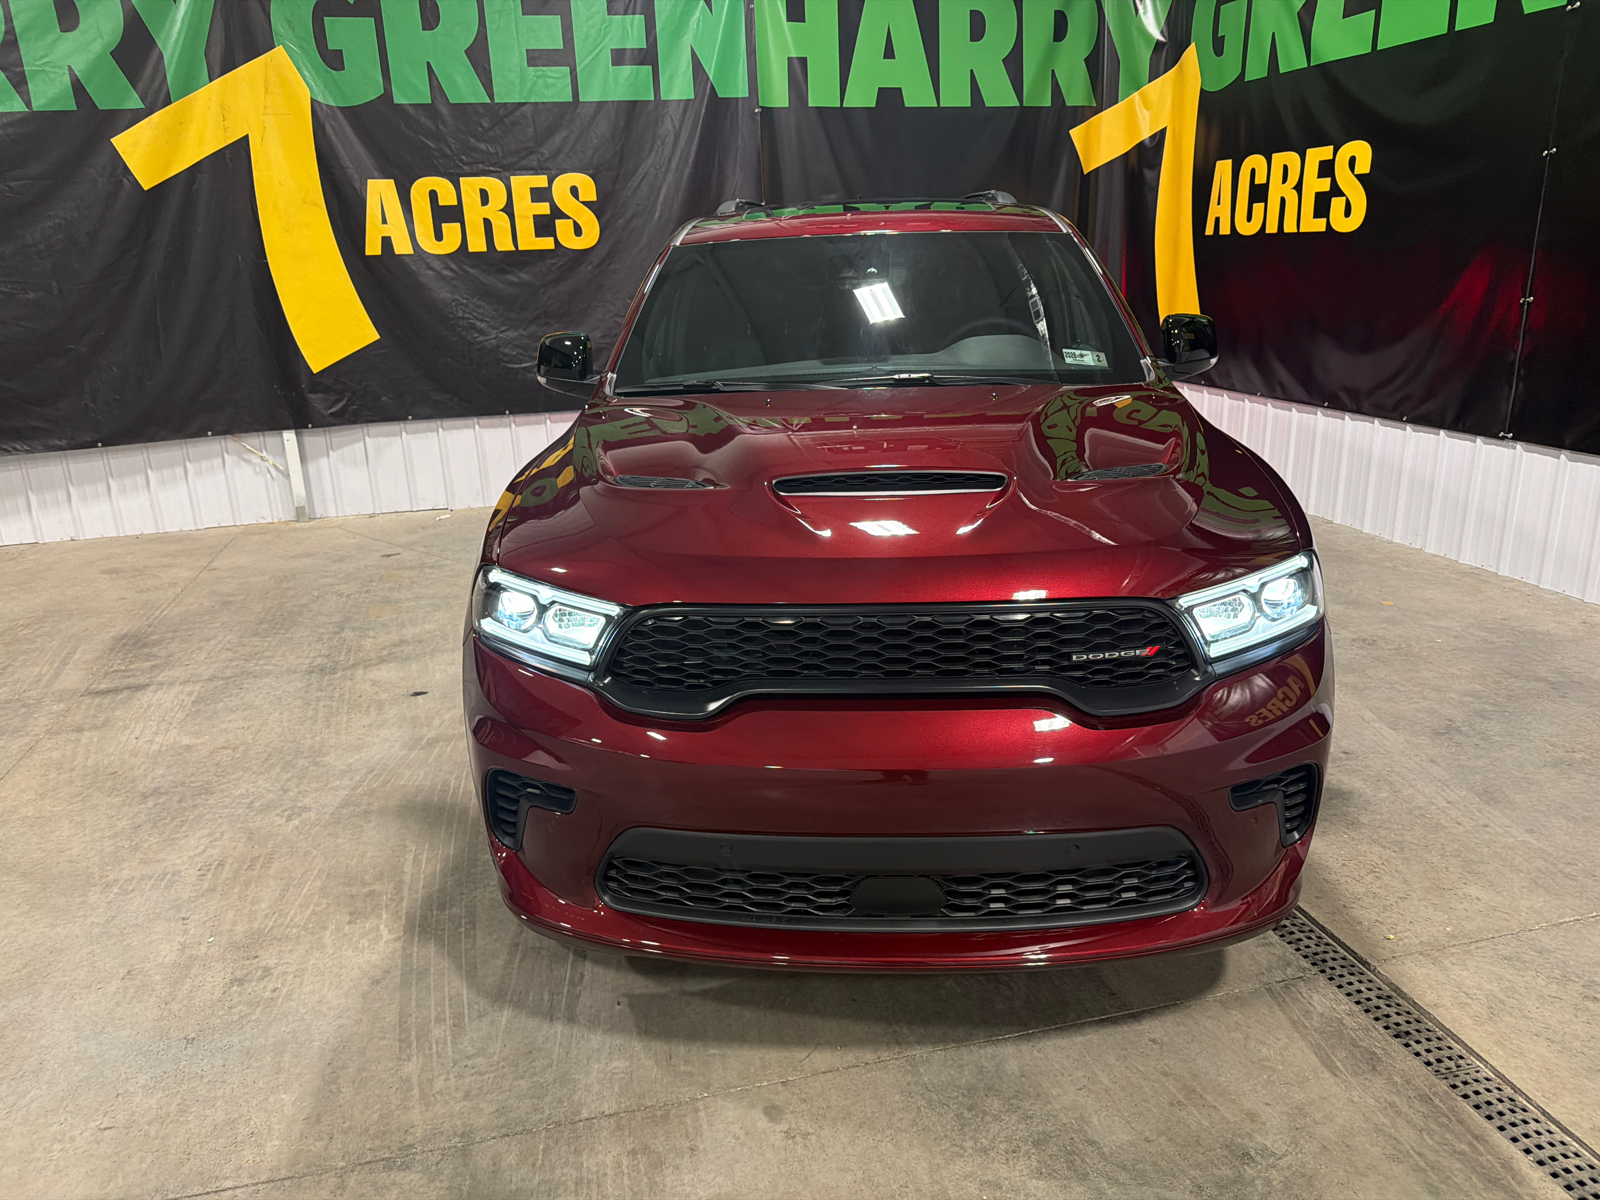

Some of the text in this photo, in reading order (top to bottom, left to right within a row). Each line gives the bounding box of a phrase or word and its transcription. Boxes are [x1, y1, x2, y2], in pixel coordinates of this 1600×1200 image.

[269, 0, 749, 108] GREEN
[755, 0, 1172, 108] HARRY
[110, 45, 601, 374] 7 ACRES
[1069, 42, 1201, 327] 7
[1204, 140, 1372, 237] ACRES
[1096, 354, 1102, 362] 2
[1072, 648, 1151, 661] DODGE
